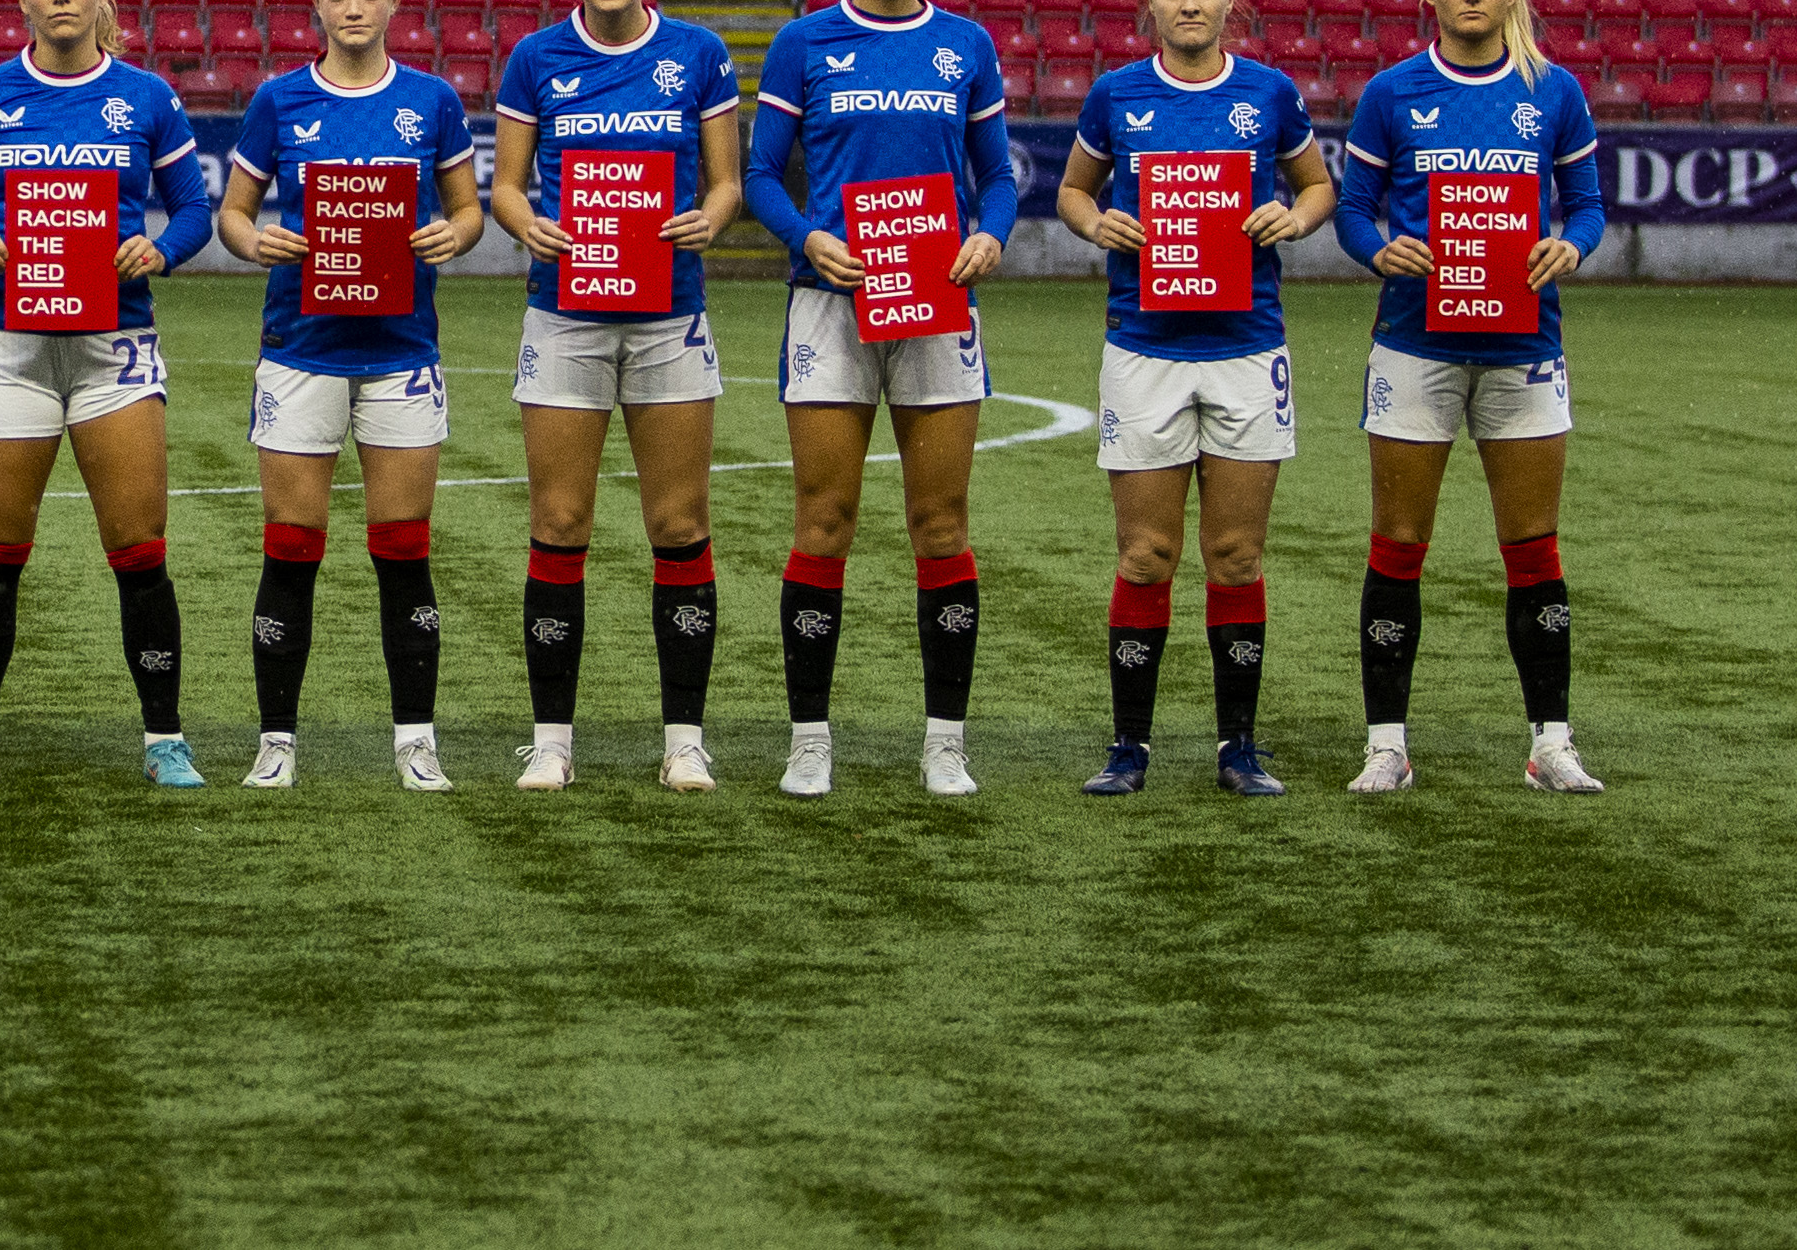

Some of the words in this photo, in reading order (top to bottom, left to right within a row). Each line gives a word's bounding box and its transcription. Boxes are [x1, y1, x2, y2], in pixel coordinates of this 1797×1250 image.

[831, 90, 957, 115] BIOWAVE
[555, 110, 682, 137] BIOWAVE
[1415, 148, 1539, 175] BIOWAVE
[573, 162, 644, 181] SHOW
[1151, 164, 1221, 183] SHOW
[1616, 147, 1779, 208] DCP
[17, 181, 88, 200] SHOW
[316, 174, 387, 193] SHOW
[572, 189, 662, 209] RACISM
[855, 188, 924, 212] SHOW
[1151, 191, 1240, 210] RACISM
[1440, 185, 1510, 203] SHOW
[17, 209, 106, 228] RACISM
[316, 200, 405, 219] RACISM
[572, 216, 619, 235] THE
[858, 213, 947, 240] RACISM
[1151, 218, 1198, 236] THE
[1440, 212, 1527, 231] RACISM
[315, 226, 362, 244] THE
[17, 236, 64, 255] THE
[571, 243, 619, 262] RED
[861, 244, 909, 266] THE
[1151, 244, 1199, 262] RED
[1440, 239, 1486, 257] THE
[315, 251, 362, 270] RED
[17, 263, 65, 281] RED
[1439, 265, 1486, 284] RED
[570, 277, 636, 296] CARD
[864, 271, 912, 293] RED
[1152, 277, 1217, 296] CARD
[313, 284, 379, 301] CARD
[17, 297, 83, 315] CARD
[868, 303, 934, 326] CARD
[1438, 299, 1503, 317] CARD
[111, 334, 159, 386] 27
[1270, 355, 1290, 410] 9
